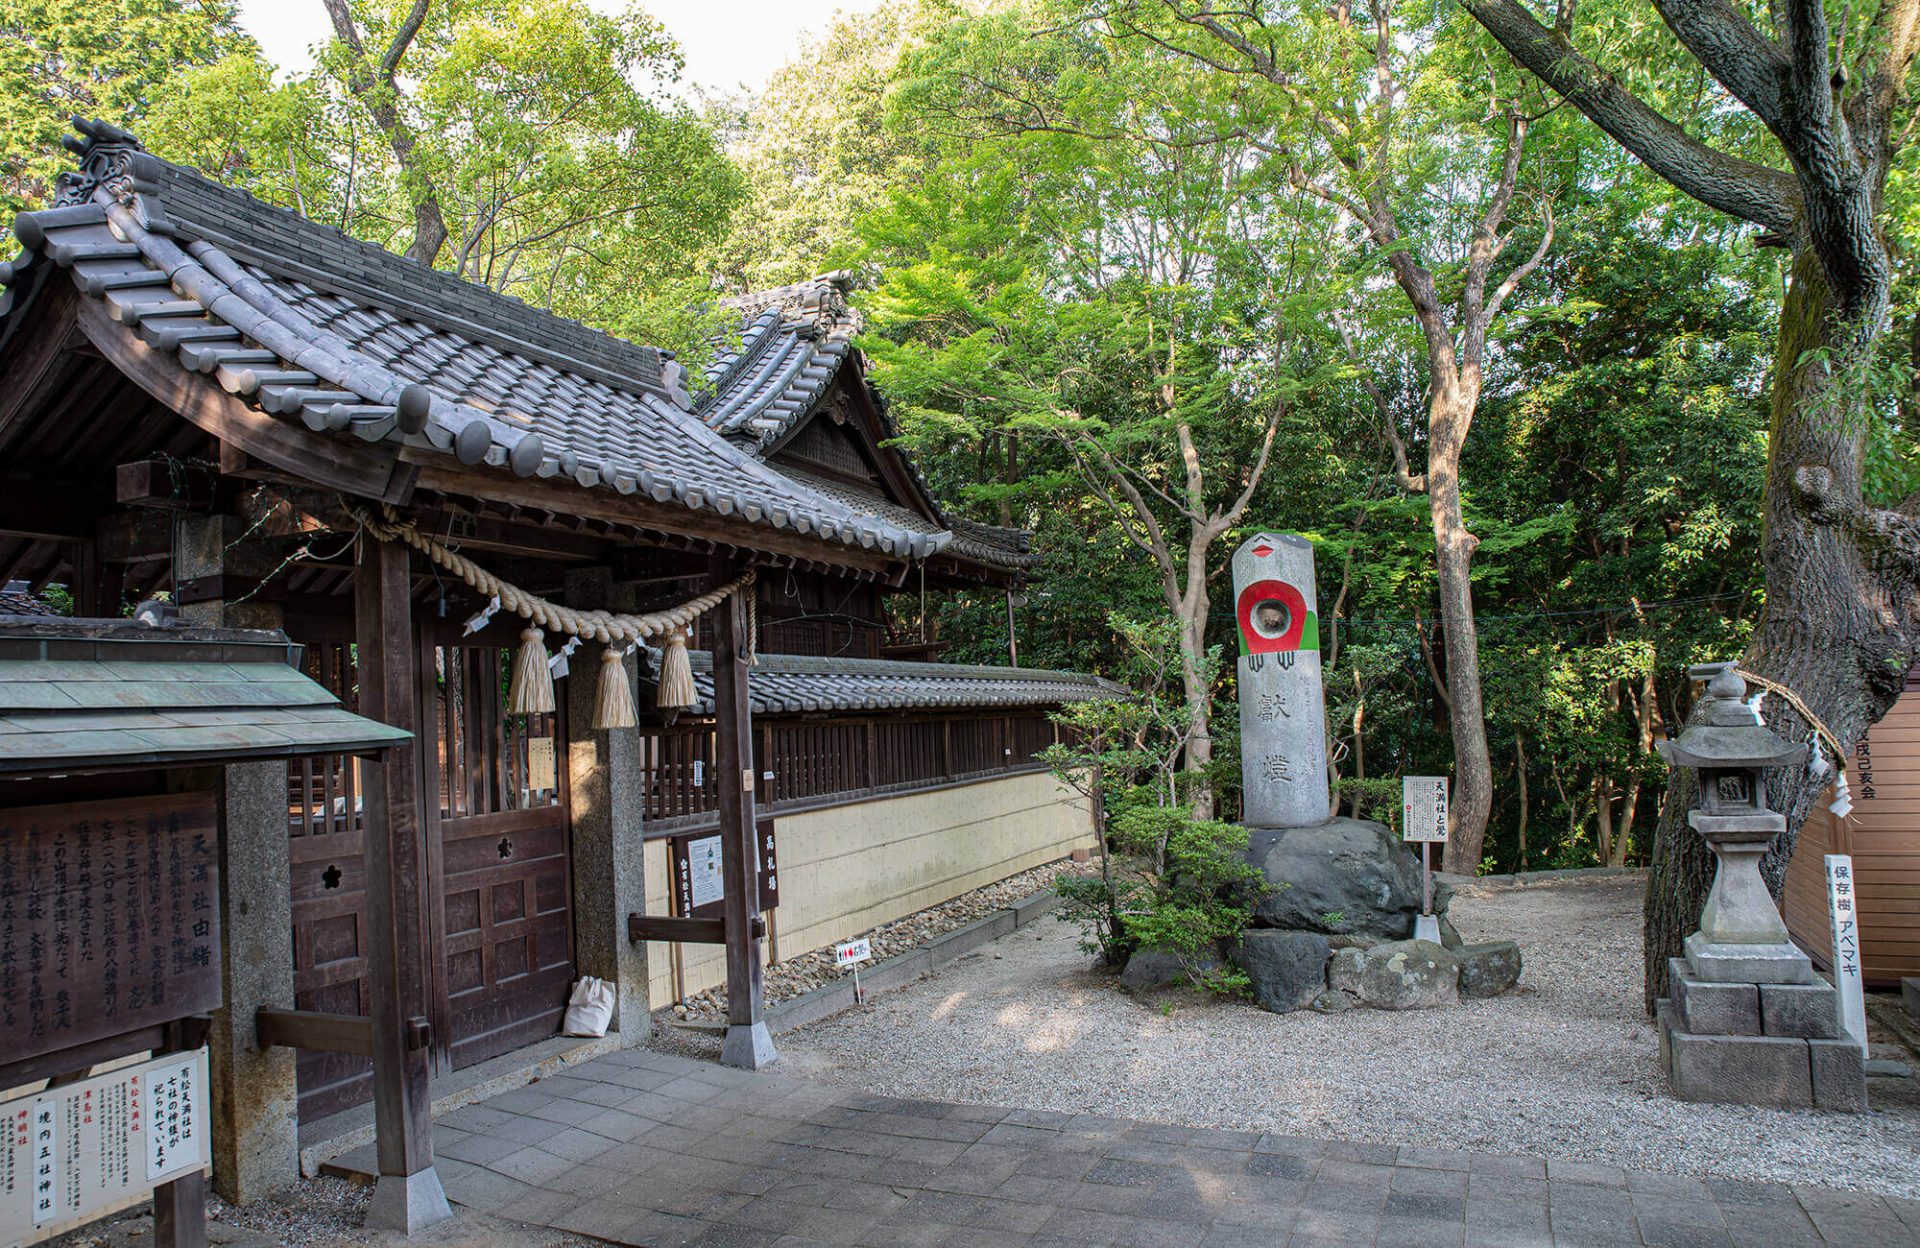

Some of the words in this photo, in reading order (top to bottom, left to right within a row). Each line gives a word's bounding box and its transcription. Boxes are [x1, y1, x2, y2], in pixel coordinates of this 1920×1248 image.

[766, 835, 776, 891] 高札場
[1834, 866, 1851, 912] 保存樹
[190, 834, 212, 967] 天満社由緒
[1840, 920, 1858, 977] アベマキ
[17, 1110, 29, 1146] 神明社
[130, 1076, 140, 1132] 有松天満社
[154, 1083, 166, 1169] 祀られています
[167, 1077, 179, 1148] 七社の神様が
[180, 1067, 192, 1139] 有松天満社は
[39, 1111, 52, 1210] 境内五社神社
